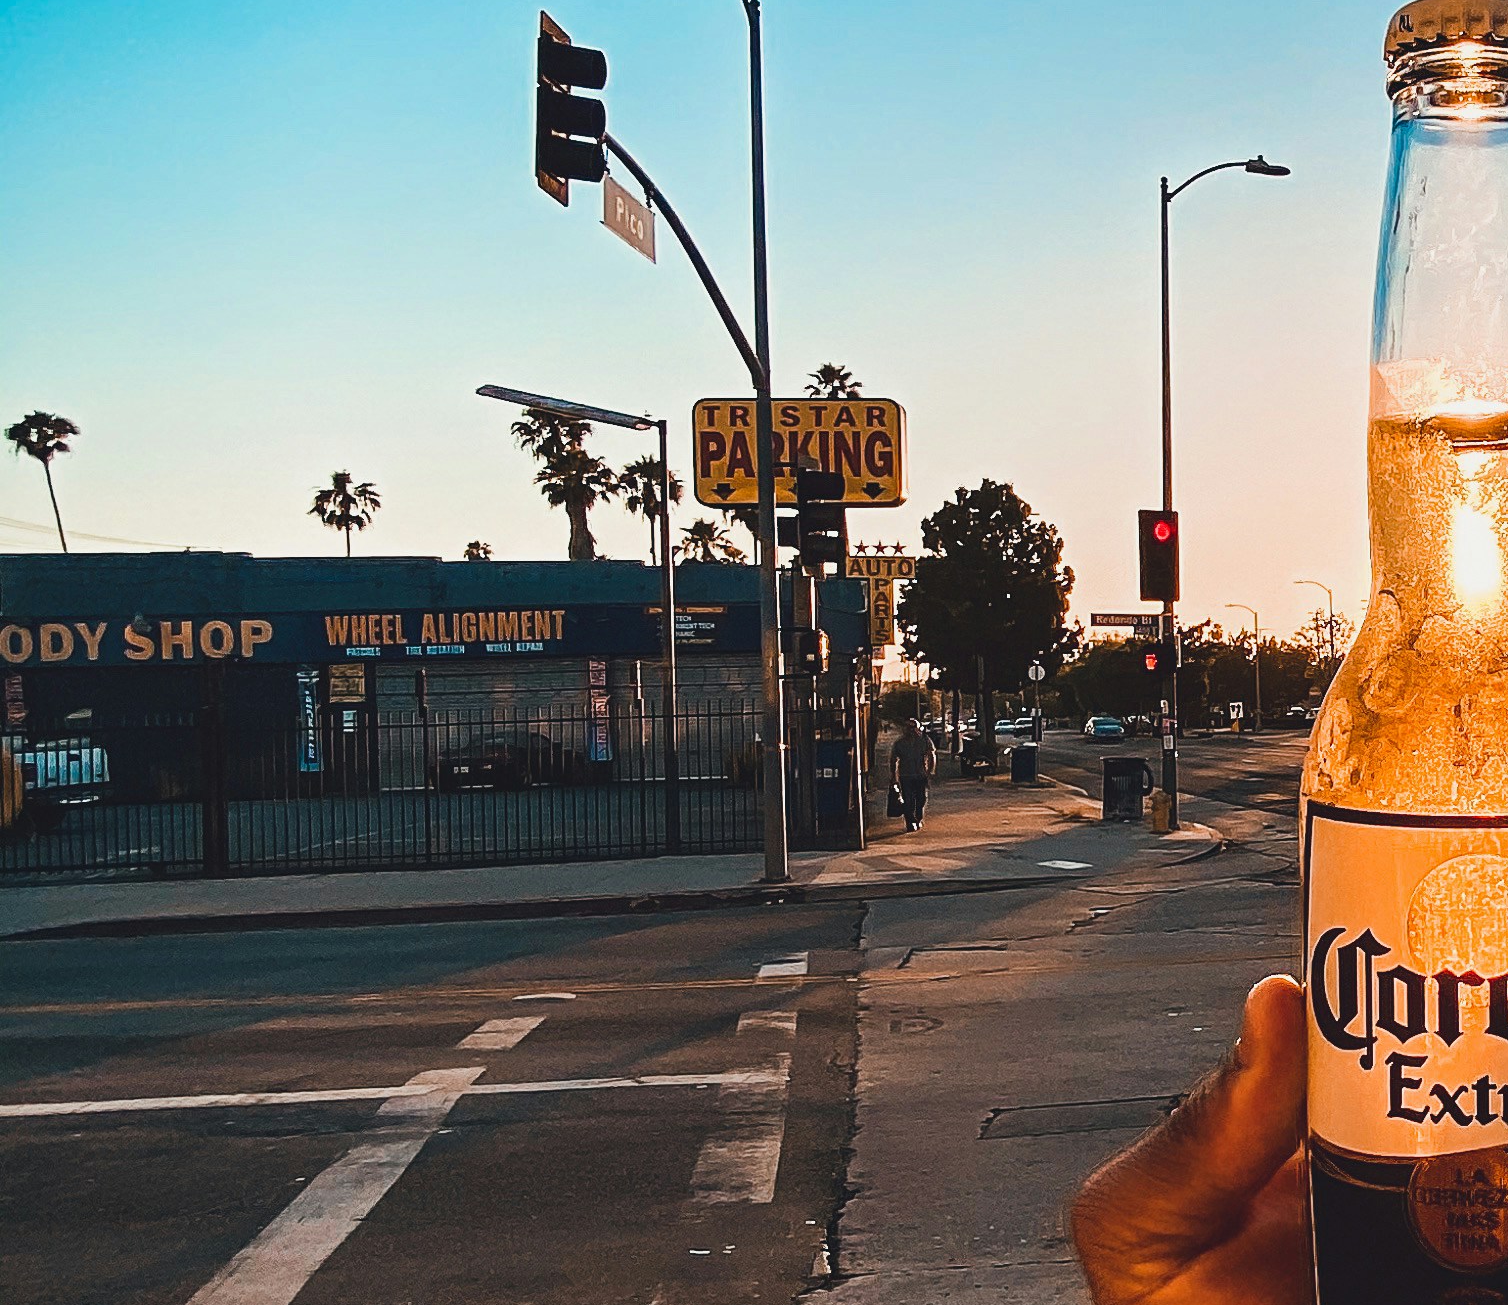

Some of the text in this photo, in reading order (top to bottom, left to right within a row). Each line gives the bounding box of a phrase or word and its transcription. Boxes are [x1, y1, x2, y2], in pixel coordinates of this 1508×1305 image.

[615, 196, 644, 240] Pico
[702, 405, 887, 427] TRSTAR
[849, 559, 913, 576] AUTO
[324, 610, 566, 645] WHEEL ALIGNMENT
[874, 578, 892, 642] PARTS
[1096, 615, 1138, 625] Redondo
[124, 620, 273, 661] SHOP
